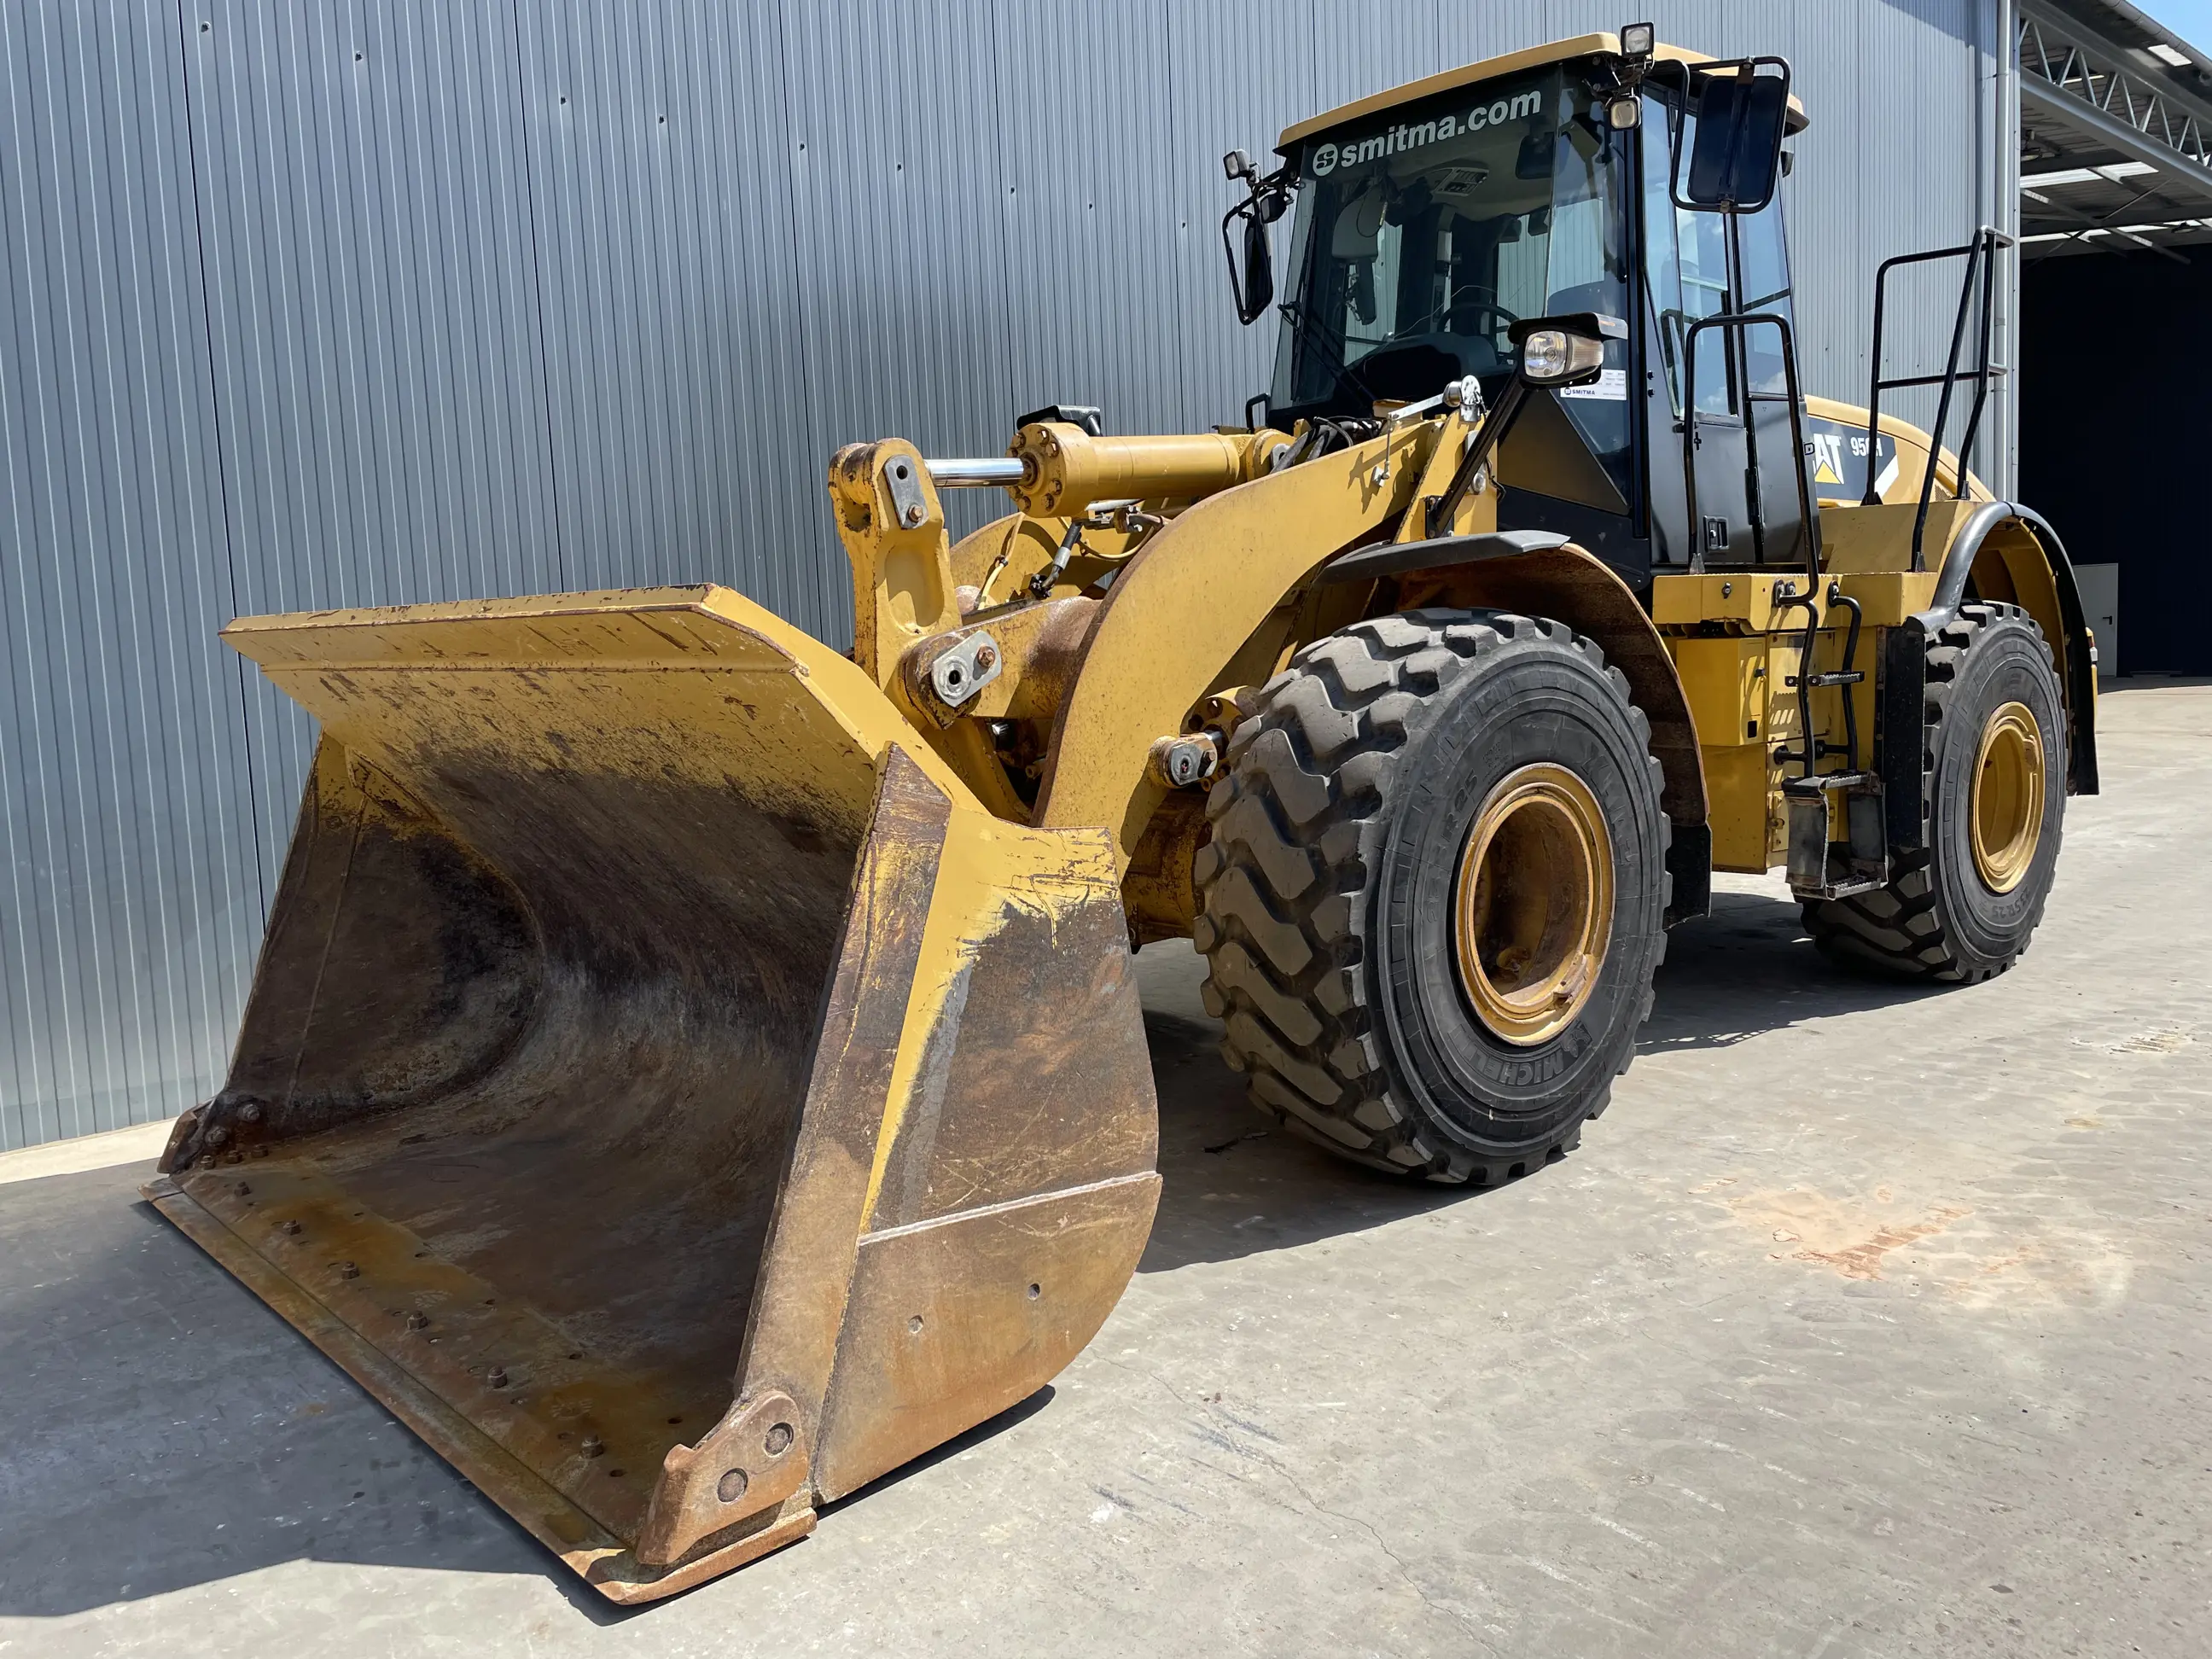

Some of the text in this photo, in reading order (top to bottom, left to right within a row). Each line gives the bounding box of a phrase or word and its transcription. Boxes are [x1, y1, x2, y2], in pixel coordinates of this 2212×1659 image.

[1340, 90, 1542, 168] smitma.com
[1812, 433, 1844, 484] AT
[1448, 1023, 1564, 1086] MICHELIN
